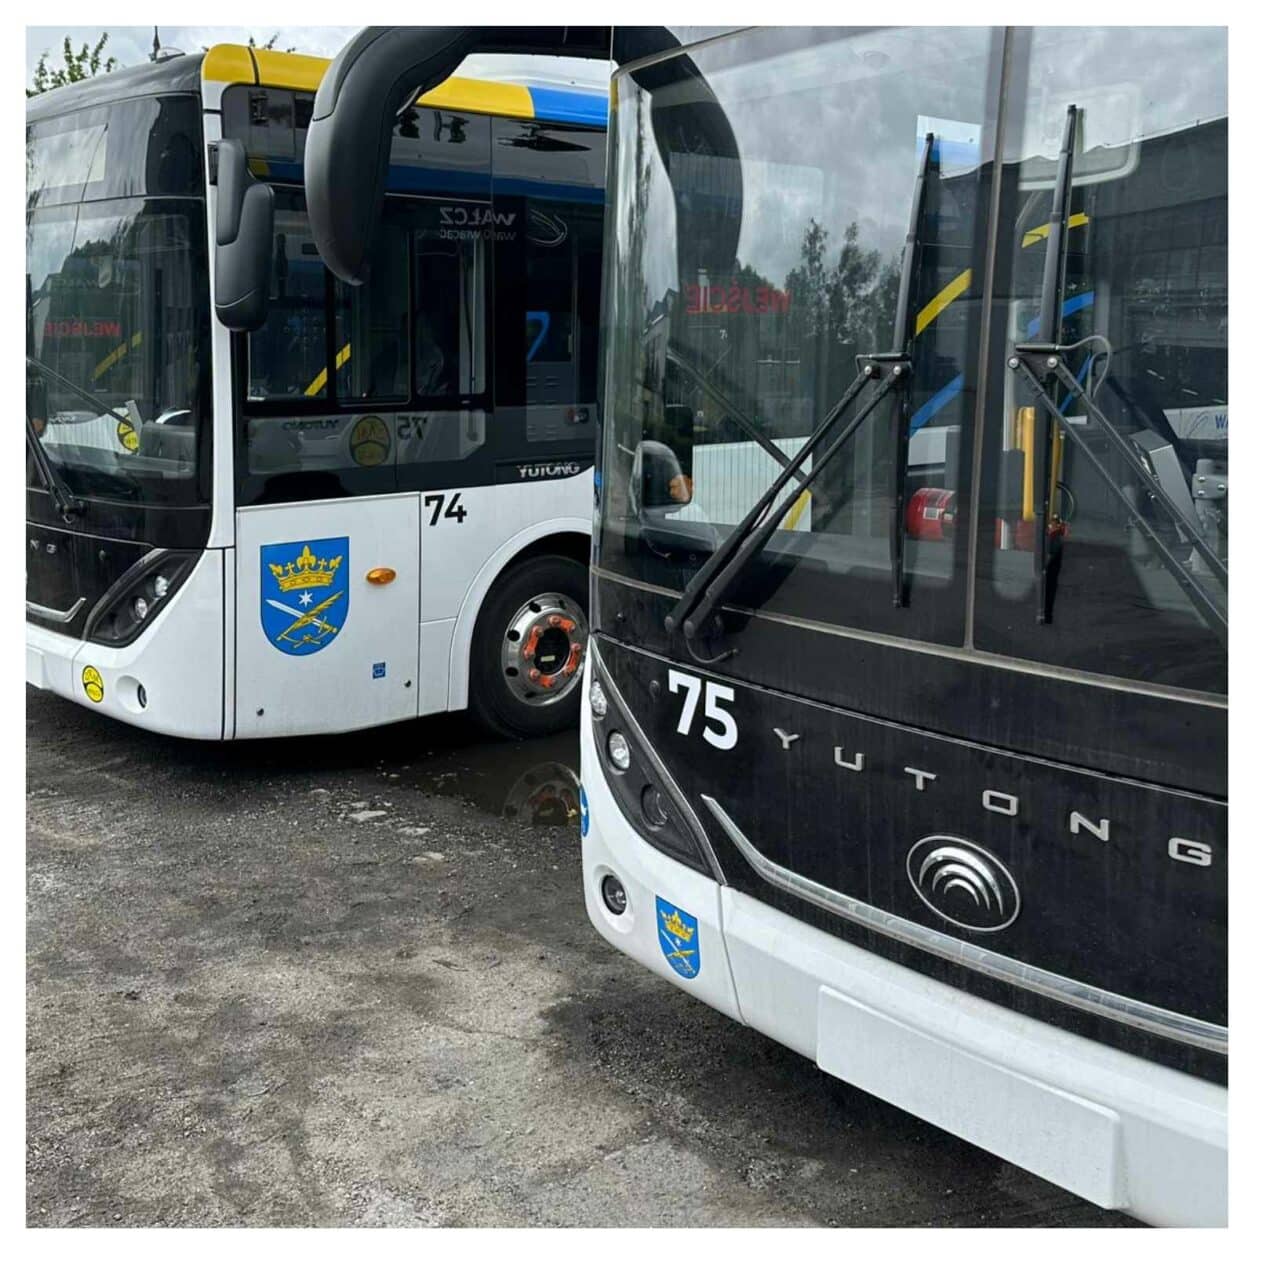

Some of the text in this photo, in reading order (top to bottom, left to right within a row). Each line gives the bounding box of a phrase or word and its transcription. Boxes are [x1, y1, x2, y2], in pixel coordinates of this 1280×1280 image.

[517, 462, 581, 478] YUTONG
[425, 492, 467, 526] 74
[668, 670, 738, 750] 75
[774, 727, 1213, 867] YUTONG
